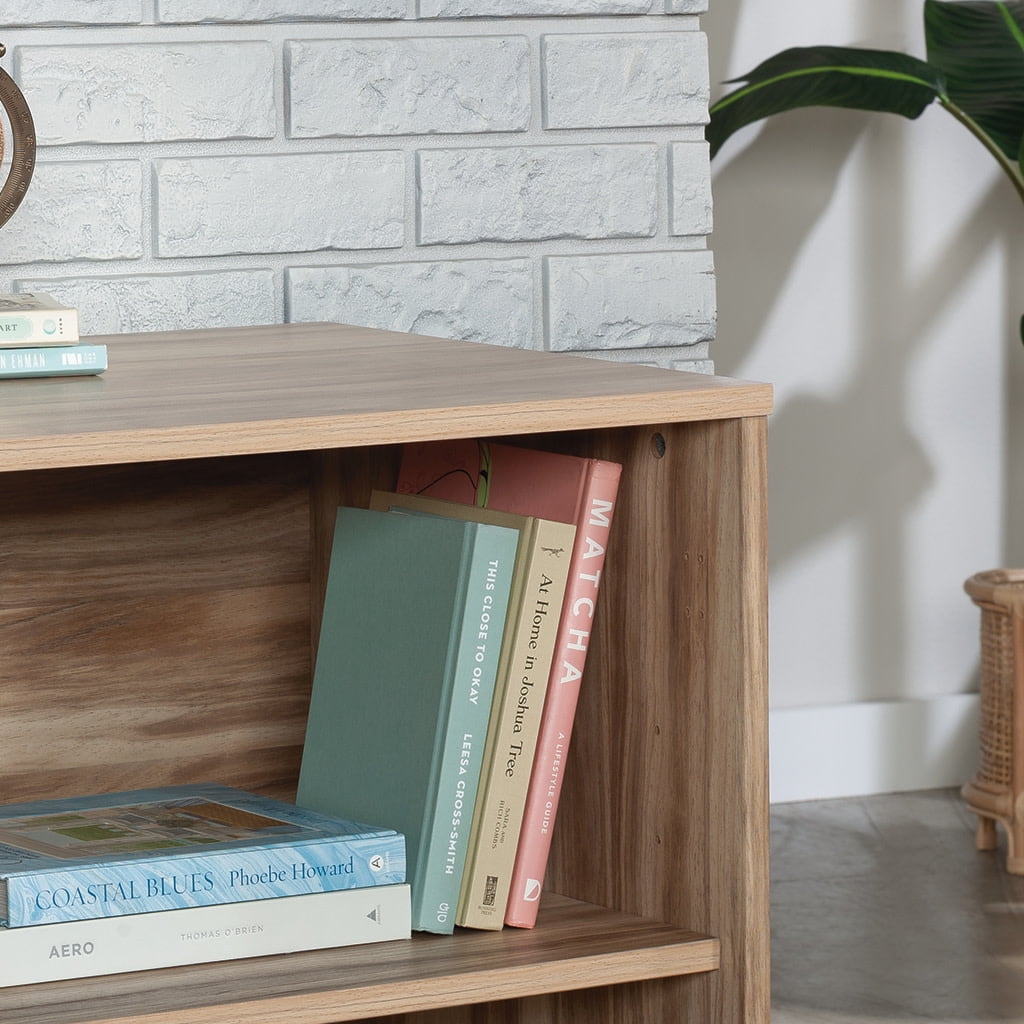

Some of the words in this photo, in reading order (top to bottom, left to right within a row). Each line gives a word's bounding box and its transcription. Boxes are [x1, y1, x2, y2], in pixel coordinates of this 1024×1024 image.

[11, 352, 46, 369] EHMAN
[485, 560, 498, 590] THIS
[538, 573, 553, 594] At
[559, 498, 613, 684] MATCHA
[478, 595, 493, 640] CLOSE
[528, 600, 549, 650] Home
[475, 645, 486, 662] TO
[524, 655, 538, 670] in
[469, 667, 482, 705] OKAY
[513, 676, 534, 734] Joshua
[557, 732, 565, 740] A
[458, 733, 472, 775] LEESA
[505, 741, 523, 778] Tree
[548, 744, 562, 797] LIFESTYLE
[445, 780, 466, 875] CROSS-SMITH
[541, 801, 553, 834] GUIDE
[230, 865, 286, 887] Phoebe
[292, 856, 354, 880] Howard
[36, 880, 140, 910] COASTAL
[147, 871, 214, 898] BLUES
[49, 942, 94, 959] AERO
[181, 929, 220, 941] THOMAS
[225, 925, 264, 937] O'BRIEN
